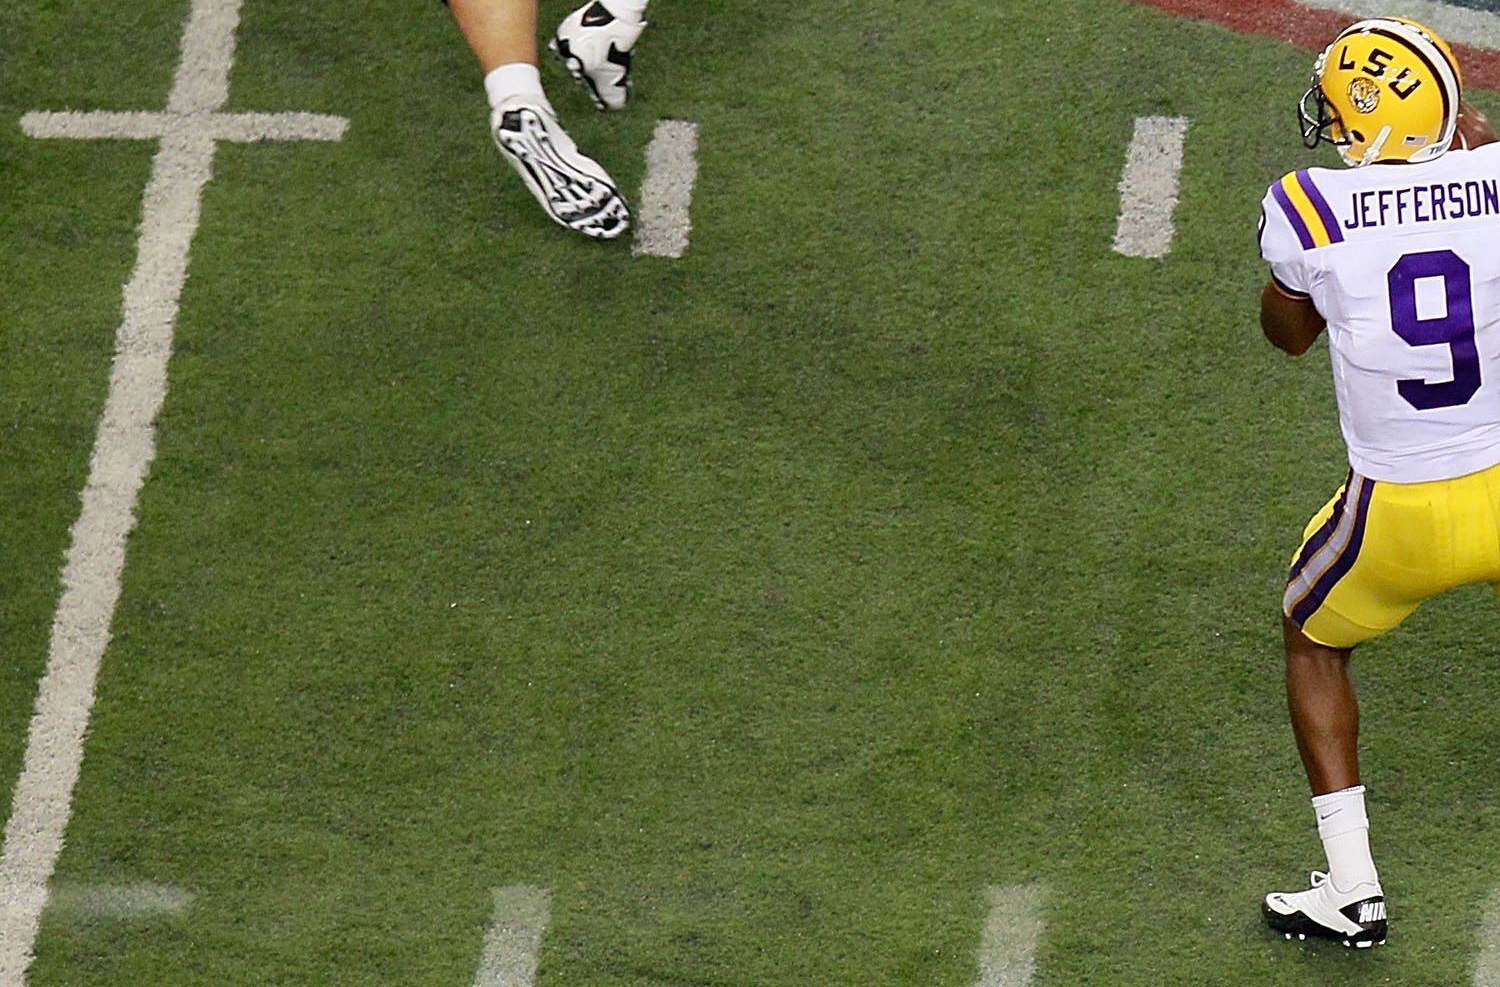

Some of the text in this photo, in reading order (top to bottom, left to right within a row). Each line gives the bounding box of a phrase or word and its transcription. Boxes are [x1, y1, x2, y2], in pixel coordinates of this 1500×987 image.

[1339, 45, 1422, 100] LSU
[1344, 179, 1500, 229] JEFFERSON
[1387, 249, 1482, 411] 9
[1359, 902, 1387, 923] NIK
